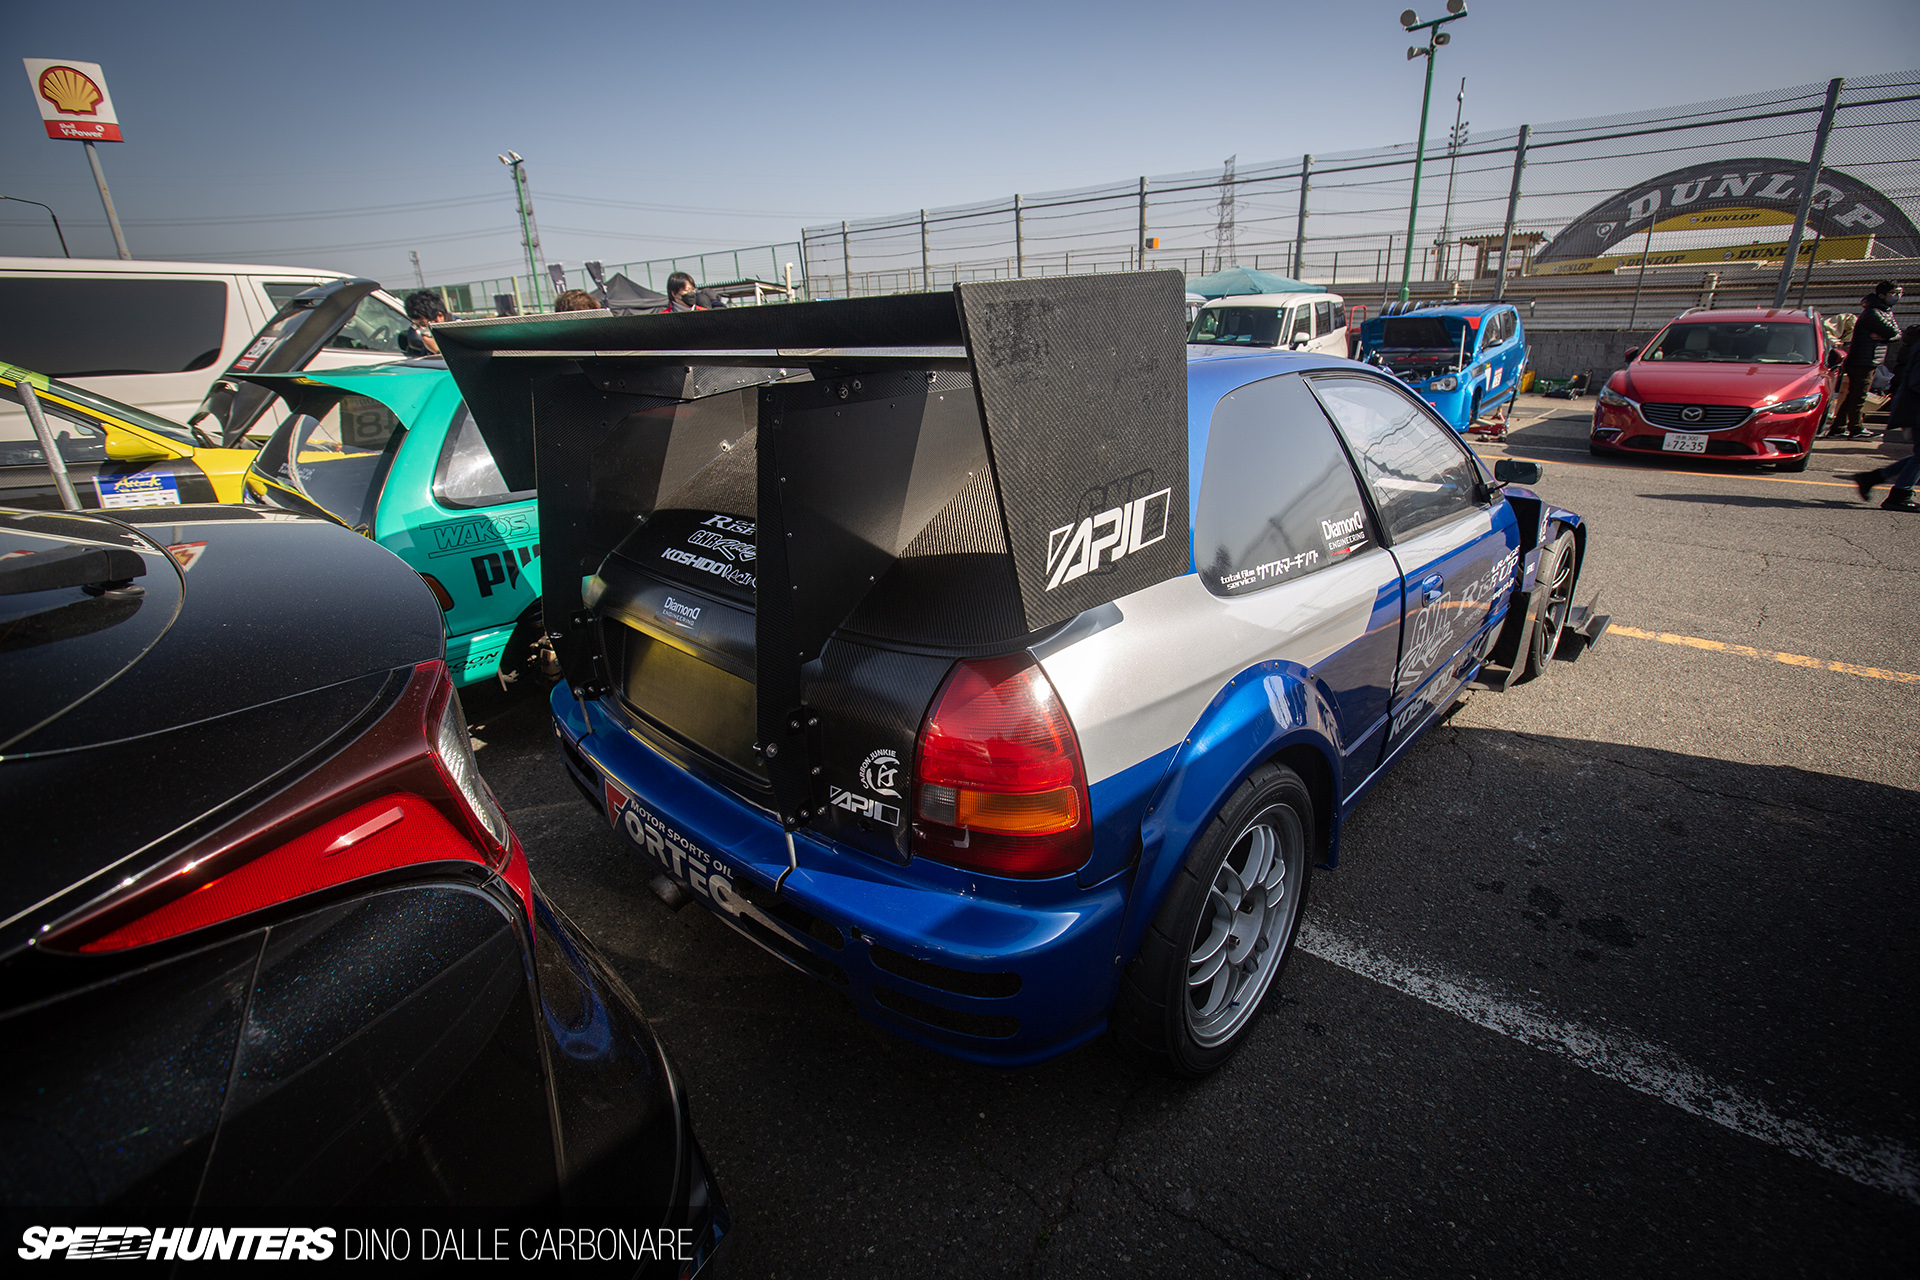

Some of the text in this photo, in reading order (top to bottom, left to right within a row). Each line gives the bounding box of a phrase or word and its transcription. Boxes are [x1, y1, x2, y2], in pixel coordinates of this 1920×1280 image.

[61, 128, 103, 138] V-Power
[1625, 172, 1885, 228] DUNLOP
[1701, 213, 1760, 223] DUNLOP
[1626, 255, 1687, 267] DUNLOP
[1673, 440, 1705, 452] 72-35
[1328, 531, 1366, 551] ENGINEERING
[661, 547, 726, 575] KOSHIDO
[1498, 555, 1519, 582] UP
[1220, 569, 1256, 585] total film
[1227, 576, 1257, 591] service
[1388, 664, 1455, 742] KOSHIDO
[859, 749, 897, 789] CARBON JUNKIE
[630, 800, 735, 880] MOTOR SPORTS OIL
